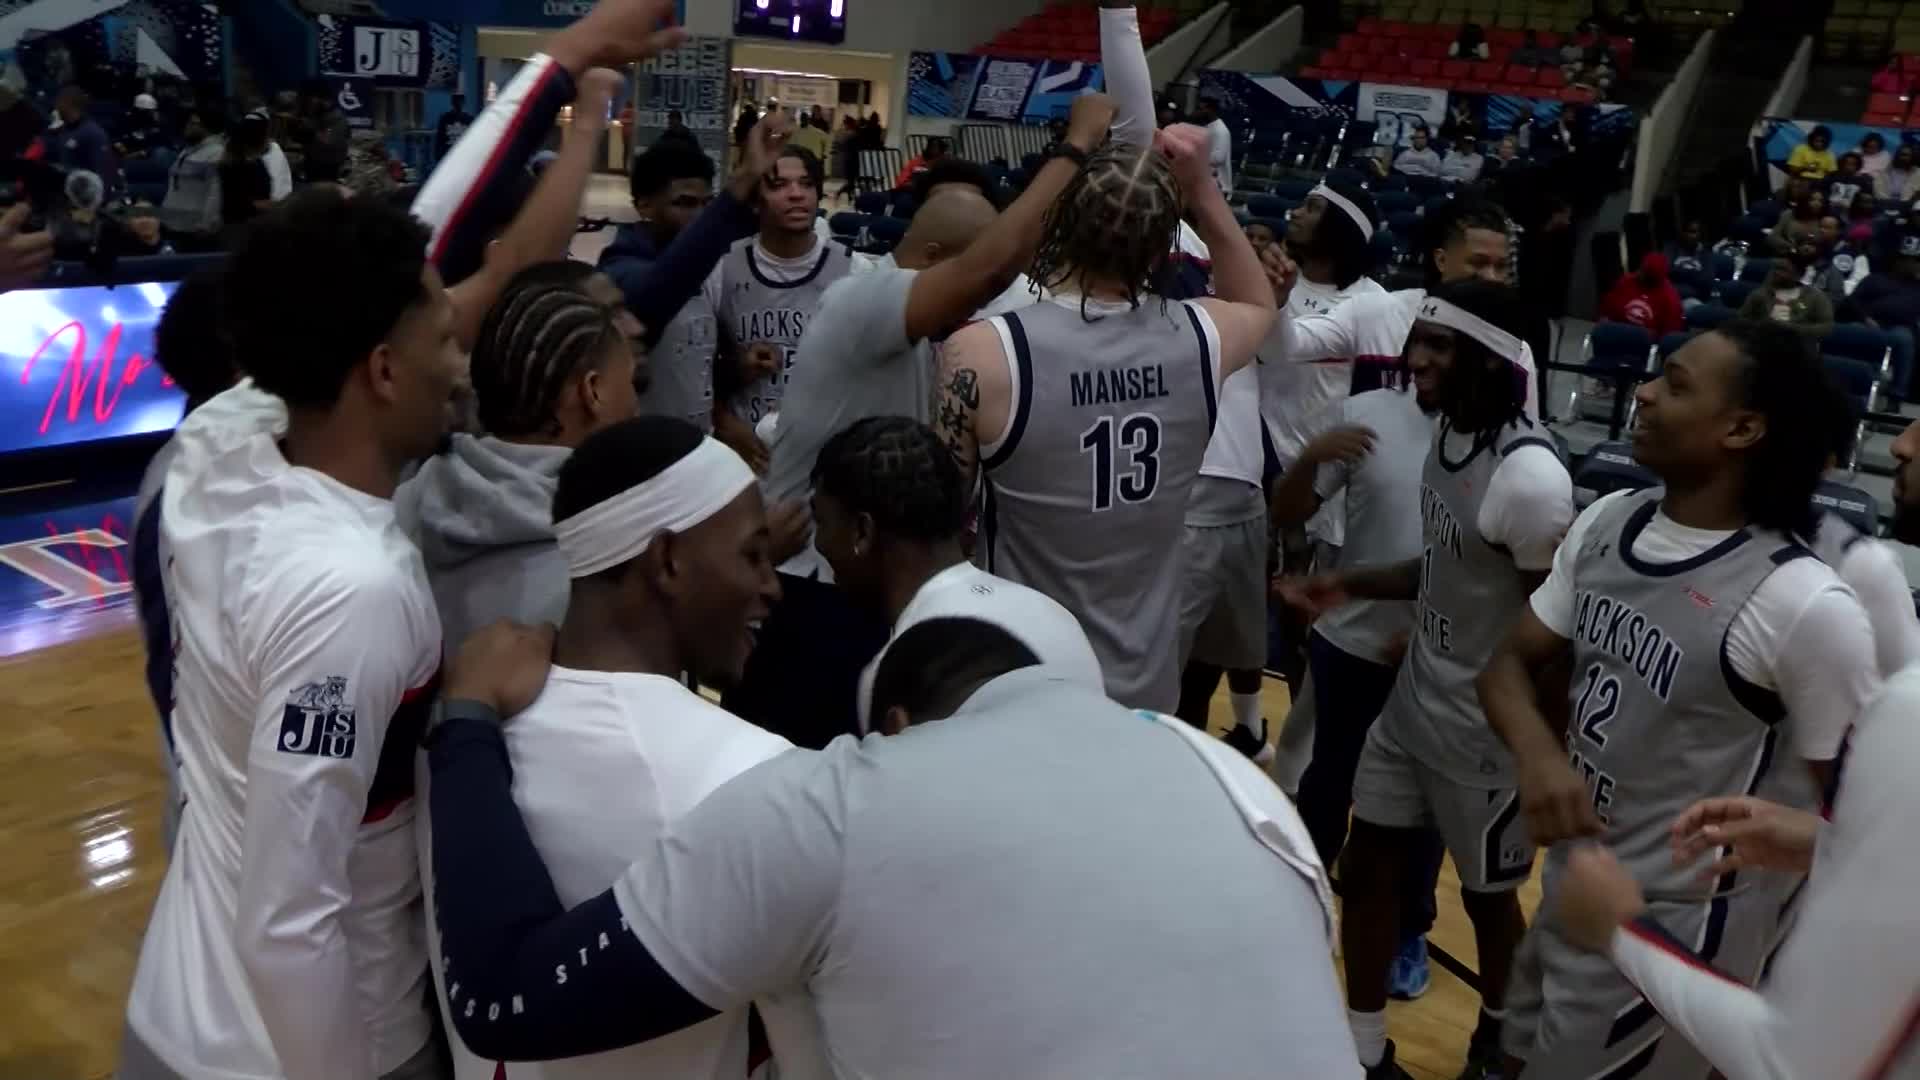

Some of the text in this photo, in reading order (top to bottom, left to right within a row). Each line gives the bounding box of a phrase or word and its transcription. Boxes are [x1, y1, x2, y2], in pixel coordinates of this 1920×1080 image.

[736, 310, 810, 342] JACKS
[1070, 363, 1169, 407] MANSEL
[1079, 411, 1162, 512] 13
[1575, 590, 1684, 704] ACKSON
[1574, 659, 1622, 752] 12
